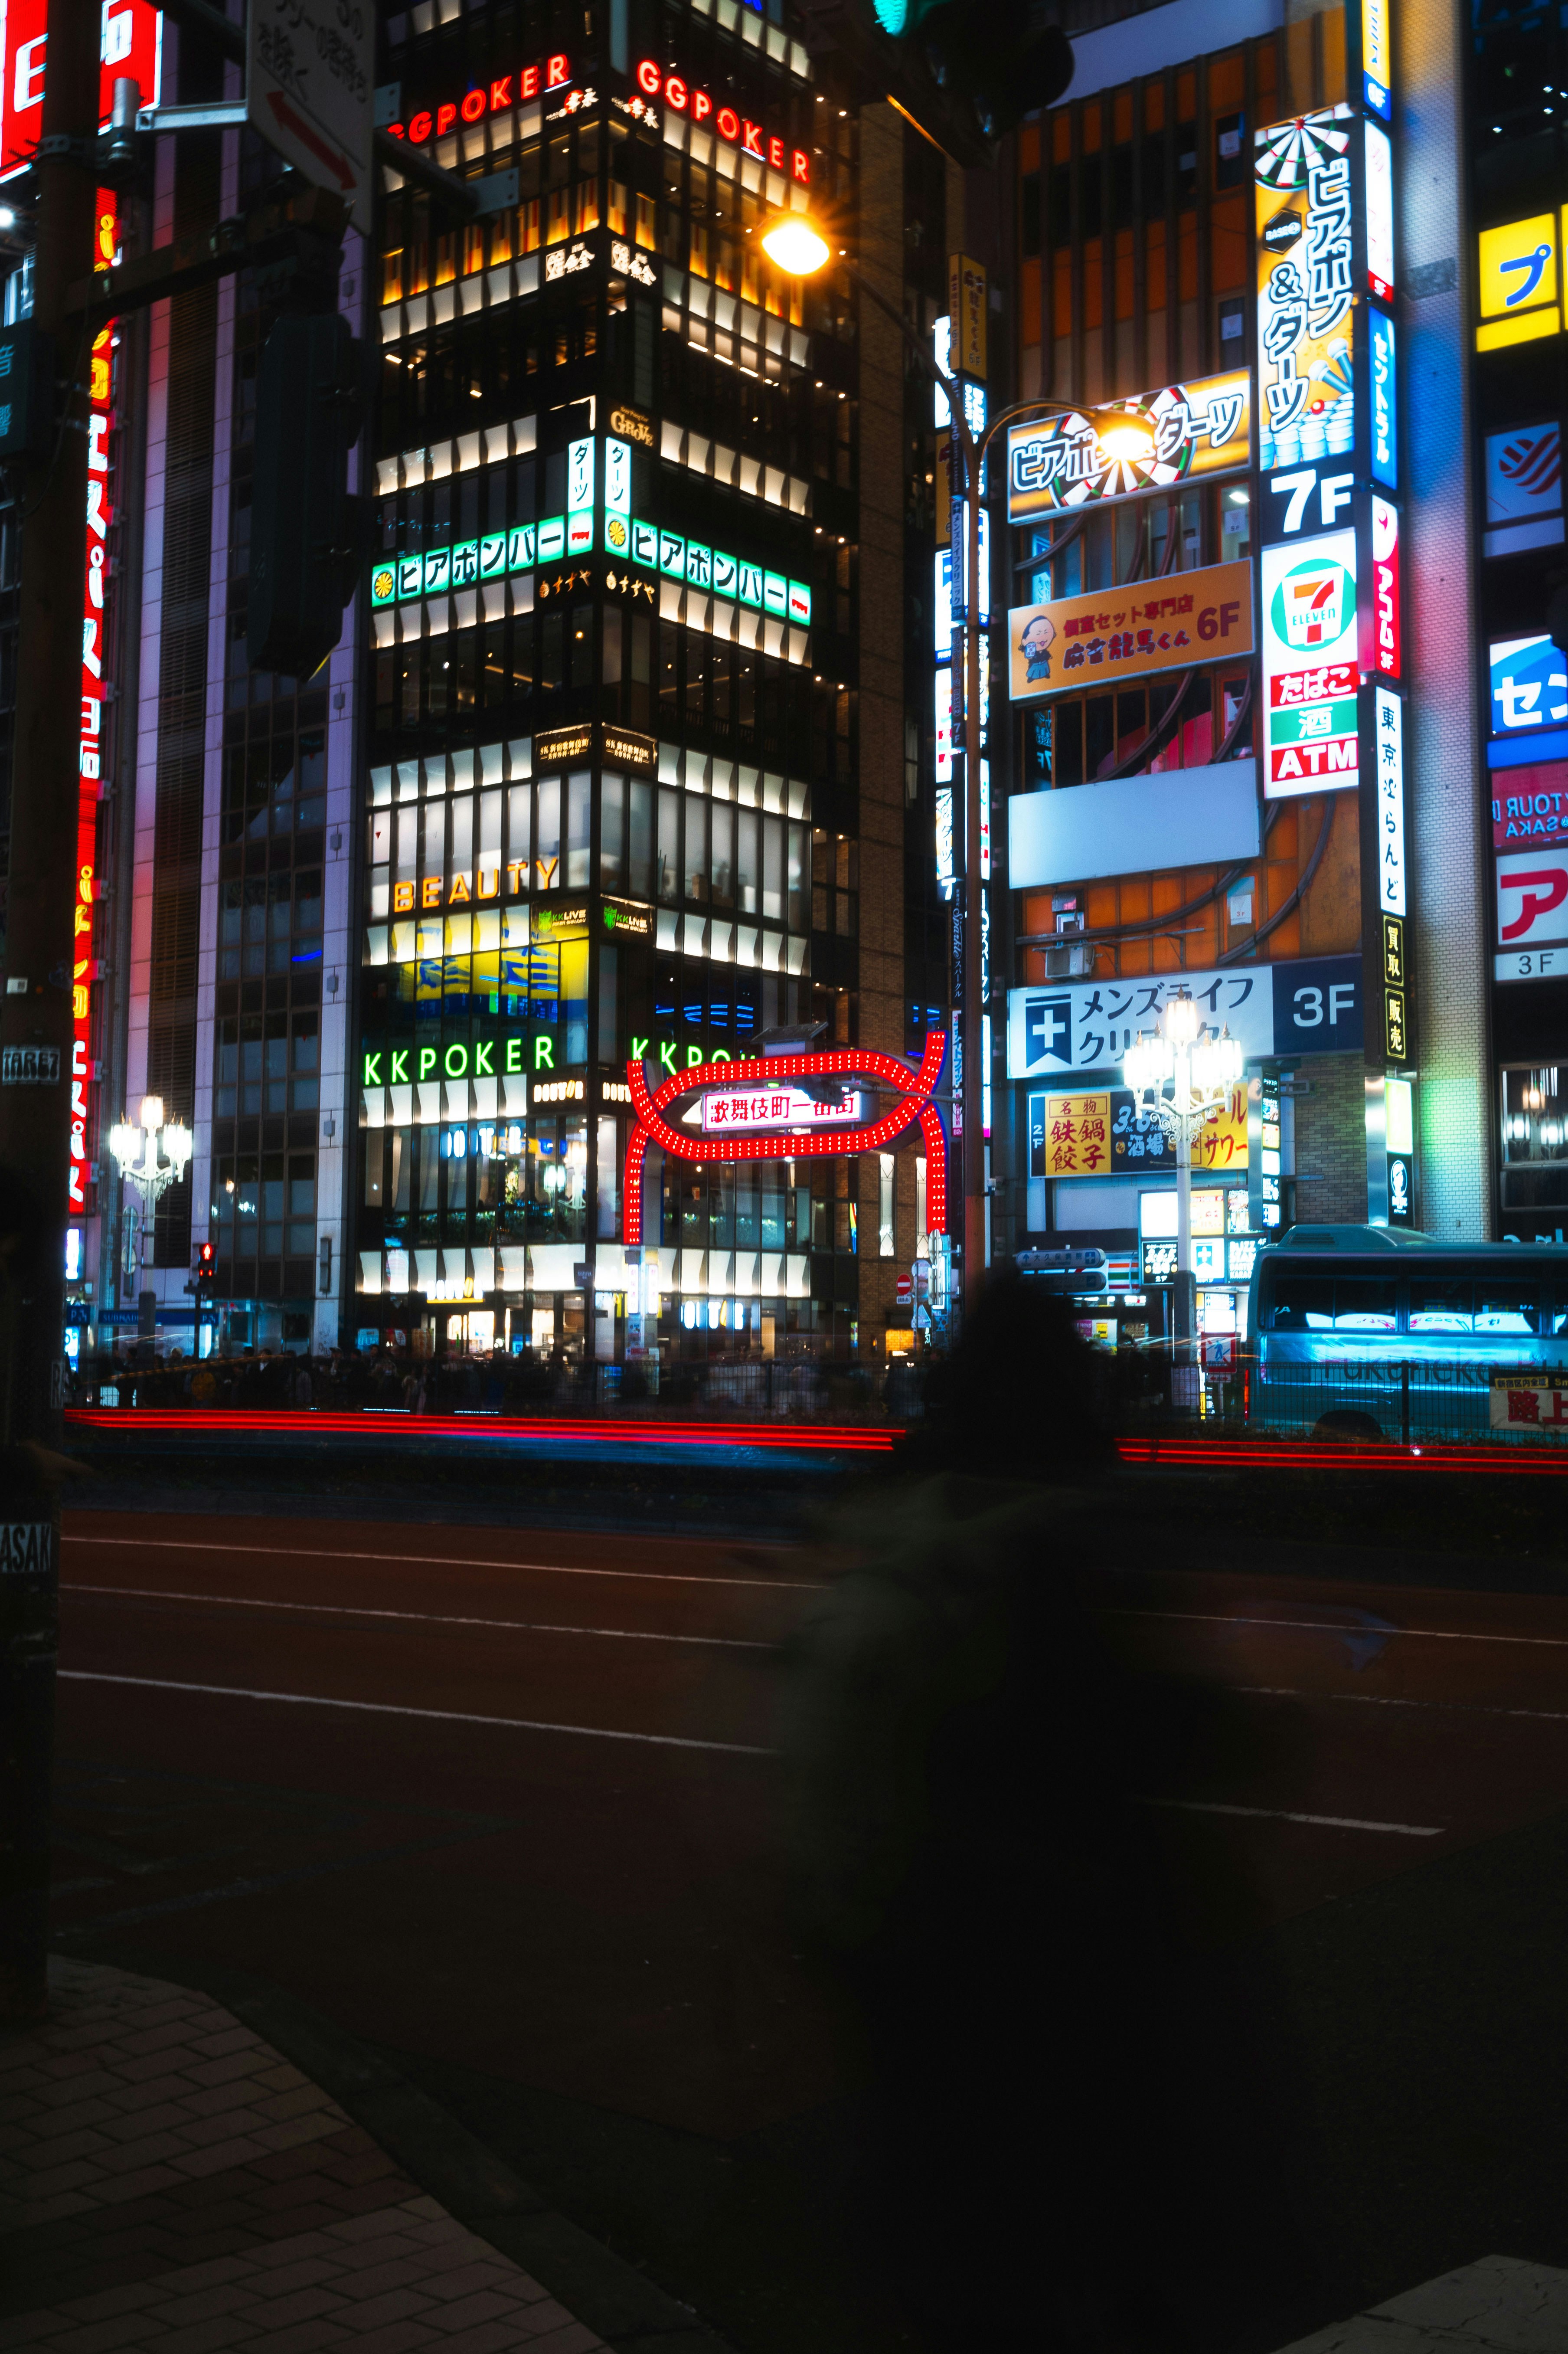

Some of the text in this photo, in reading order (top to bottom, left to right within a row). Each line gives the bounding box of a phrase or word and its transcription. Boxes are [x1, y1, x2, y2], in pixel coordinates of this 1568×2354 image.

[637, 60, 810, 183] GGPOKER
[1307, 157, 1352, 339] ビアポン
[1500, 245, 1551, 308] プ
[1374, 332, 1389, 464] セントラル
[611, 411, 653, 446] GROVE
[1013, 393, 1244, 491] ビアポダーツ
[575, 444, 589, 502] ダーツ
[613, 446, 624, 501] ダーツ
[1271, 468, 1352, 533] 7F
[399, 524, 562, 594] ビアポンバー
[634, 525, 783, 603] ビアポンバー
[1063, 593, 1194, 639] 個室セット専門店
[1197, 602, 1241, 641] 6F
[1378, 566, 1394, 650] アコム
[1063, 629, 1191, 669] 麻雀龍馬くん
[1279, 667, 1352, 704] たばこ
[1299, 706, 1333, 739] 酒
[1278, 739, 1356, 779] ATM
[394, 858, 558, 912] BEAUTY
[1501, 868, 1568, 941] ア
[952, 907, 963, 959] Sparkle
[1388, 925, 1400, 978] 買取
[1519, 953, 1554, 975] 3F
[1079, 978, 1253, 1023] メンズライフ
[1293, 983, 1355, 1028] 3F
[1079, 1021, 1219, 1064] クリク
[1389, 998, 1402, 1051] 販売
[365, 1035, 555, 1085] KKPOKER
[534, 1080, 583, 1103] DOUTOR
[1060, 1100, 1097, 1116] 名物
[1033, 1125, 1044, 1149] 2F
[1050, 1119, 1106, 1144] 鉄鍋
[1128, 1133, 1164, 1157] 酒場
[1205, 1131, 1248, 1166] サワー
[1050, 1145, 1105, 1172] 餃子
[1034, 1252, 1083, 1262] 大久保病院
